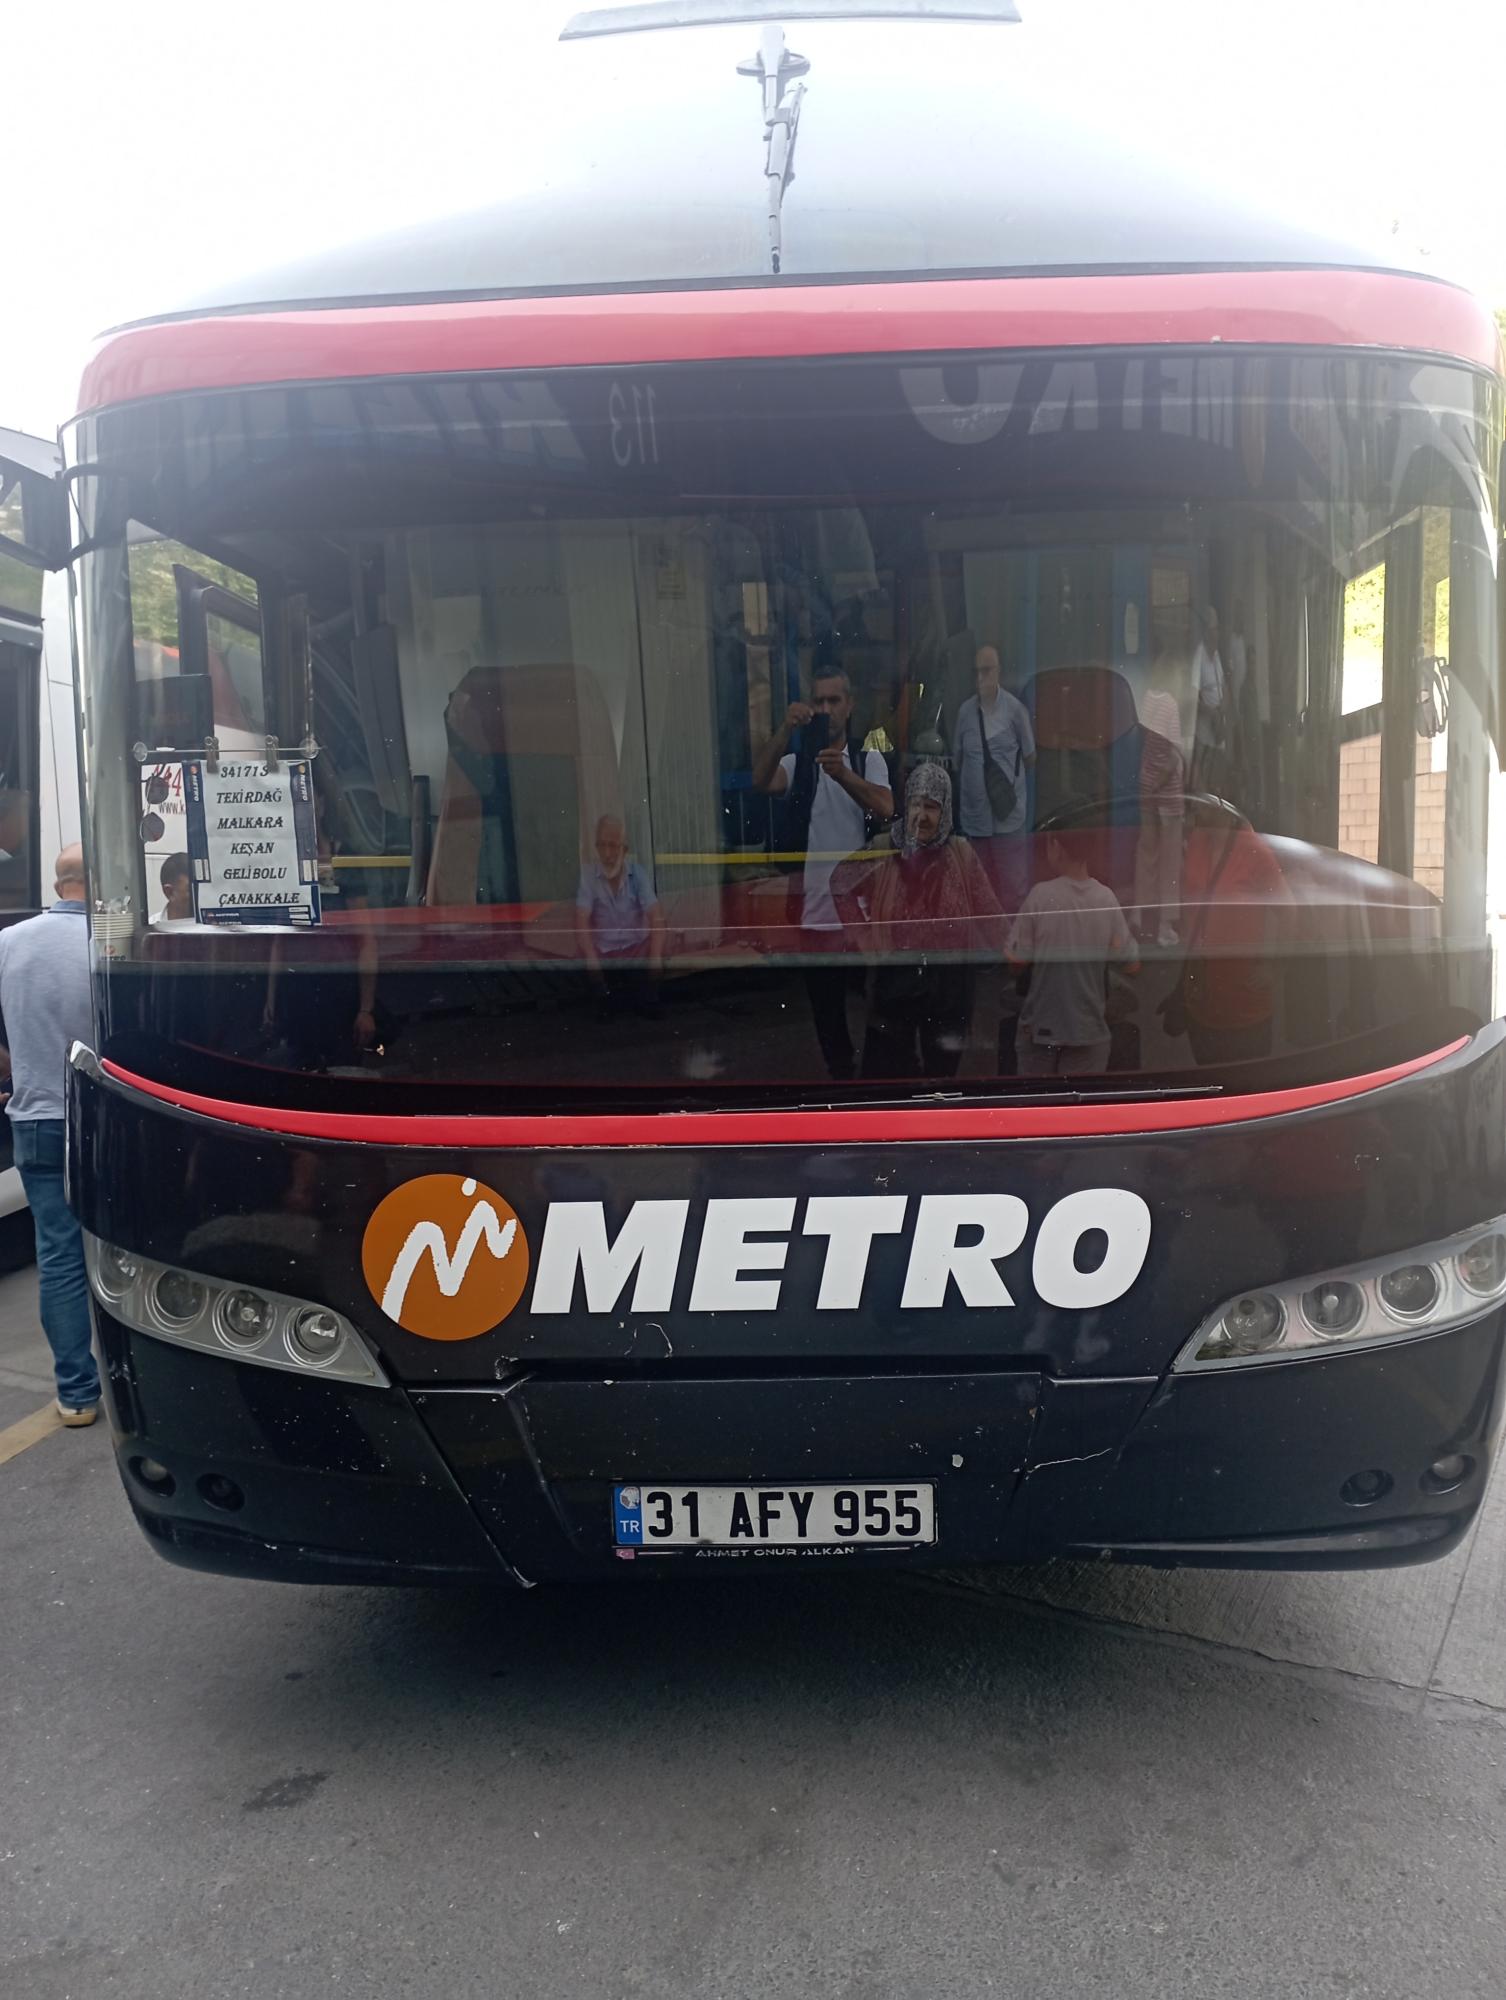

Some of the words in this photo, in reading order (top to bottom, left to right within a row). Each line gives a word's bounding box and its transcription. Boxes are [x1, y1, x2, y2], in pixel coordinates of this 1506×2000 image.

[216, 788, 282, 804] TEKİRDAĞ
[216, 816, 284, 830] MALKARA
[230, 842, 275, 857] KEŞAN
[223, 865, 288, 880] GELİBOLU
[218, 892, 300, 908] ÇANAKKALE
[529, 1187, 1153, 1314] METRO
[646, 1490, 700, 1538] 31
[729, 1489, 815, 1538] AFY
[833, 1489, 922, 1537] 955
[619, 1519, 640, 1533] TR
[695, 1549, 750, 1558] AHMET
[801, 1546, 855, 1556] ALKAN
